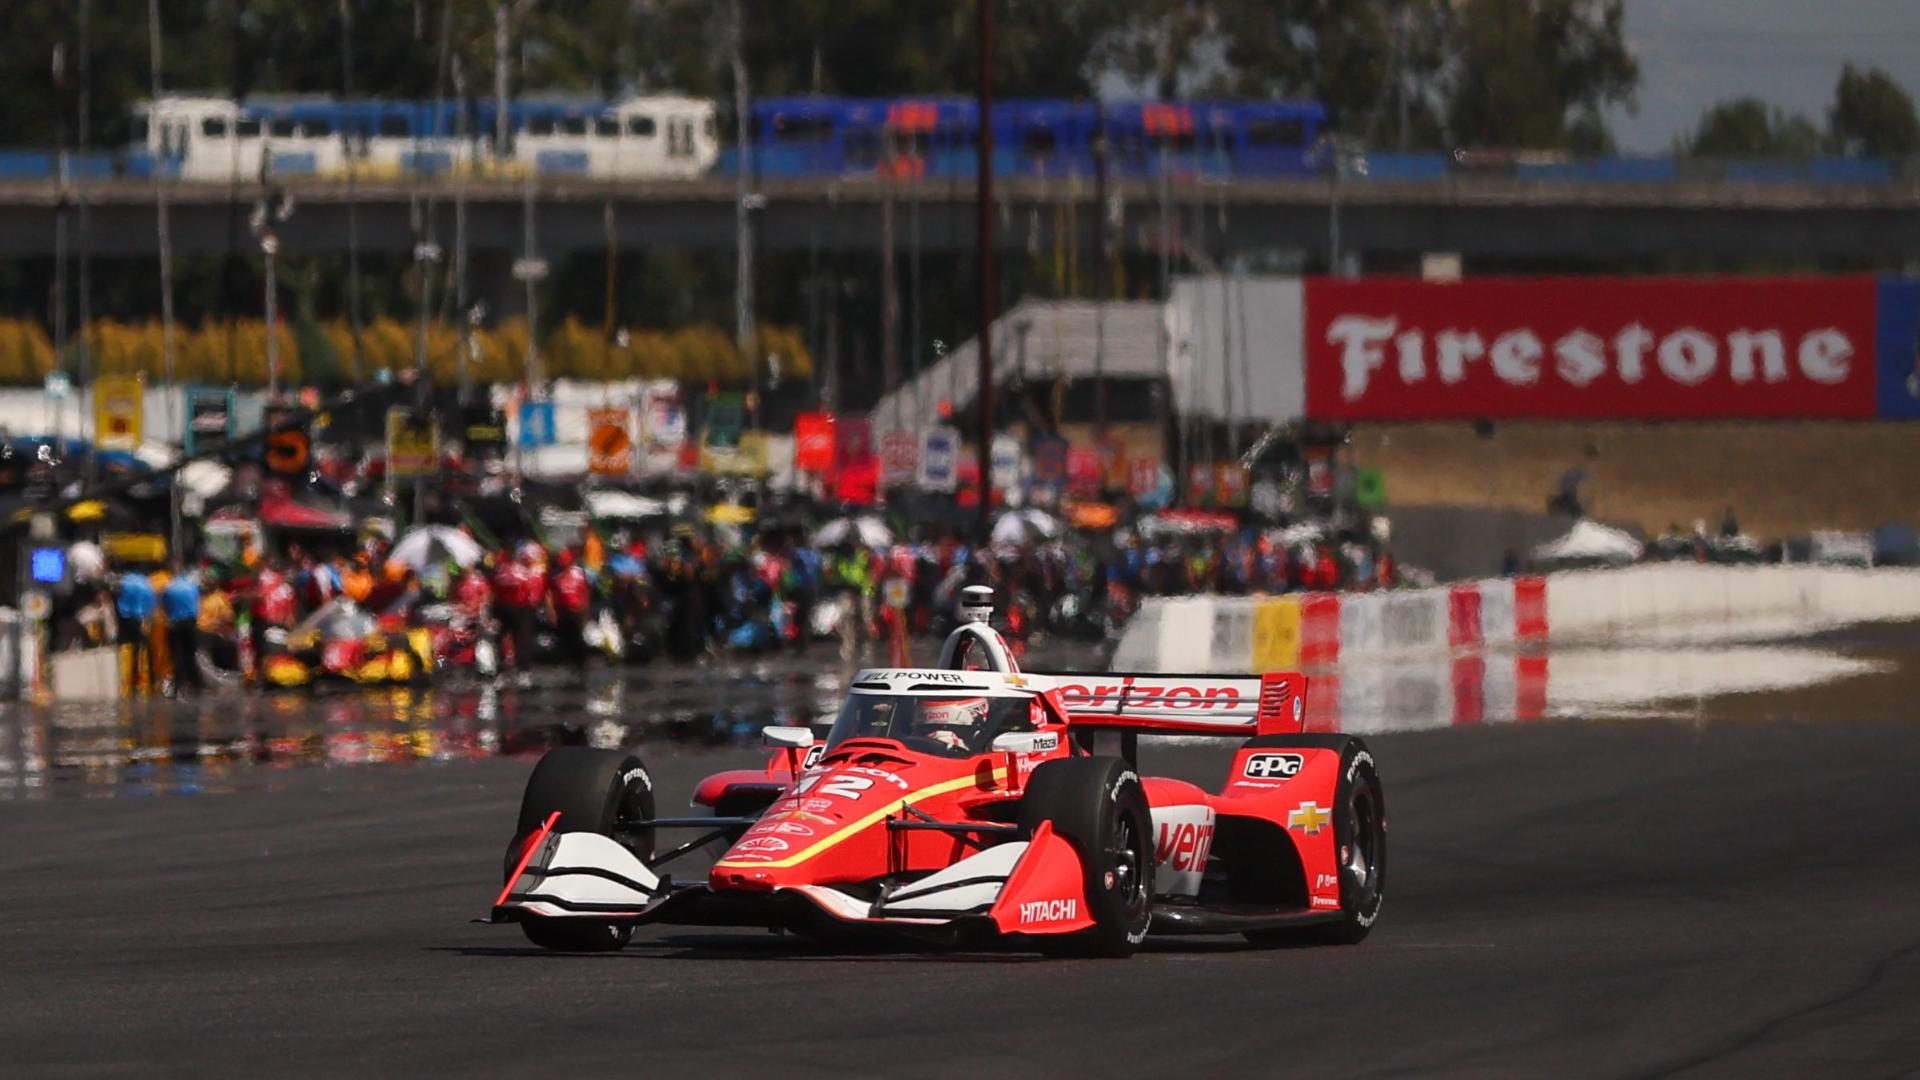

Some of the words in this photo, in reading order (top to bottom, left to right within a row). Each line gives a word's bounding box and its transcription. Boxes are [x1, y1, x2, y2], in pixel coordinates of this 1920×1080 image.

[1325, 313, 1853, 401] Firestone
[894, 672, 965, 683] POWER
[1060, 677, 1240, 709] erizon
[1033, 738, 1057, 750] Maza
[1248, 757, 1300, 776] PPG
[1020, 898, 1076, 924] HITACHI
